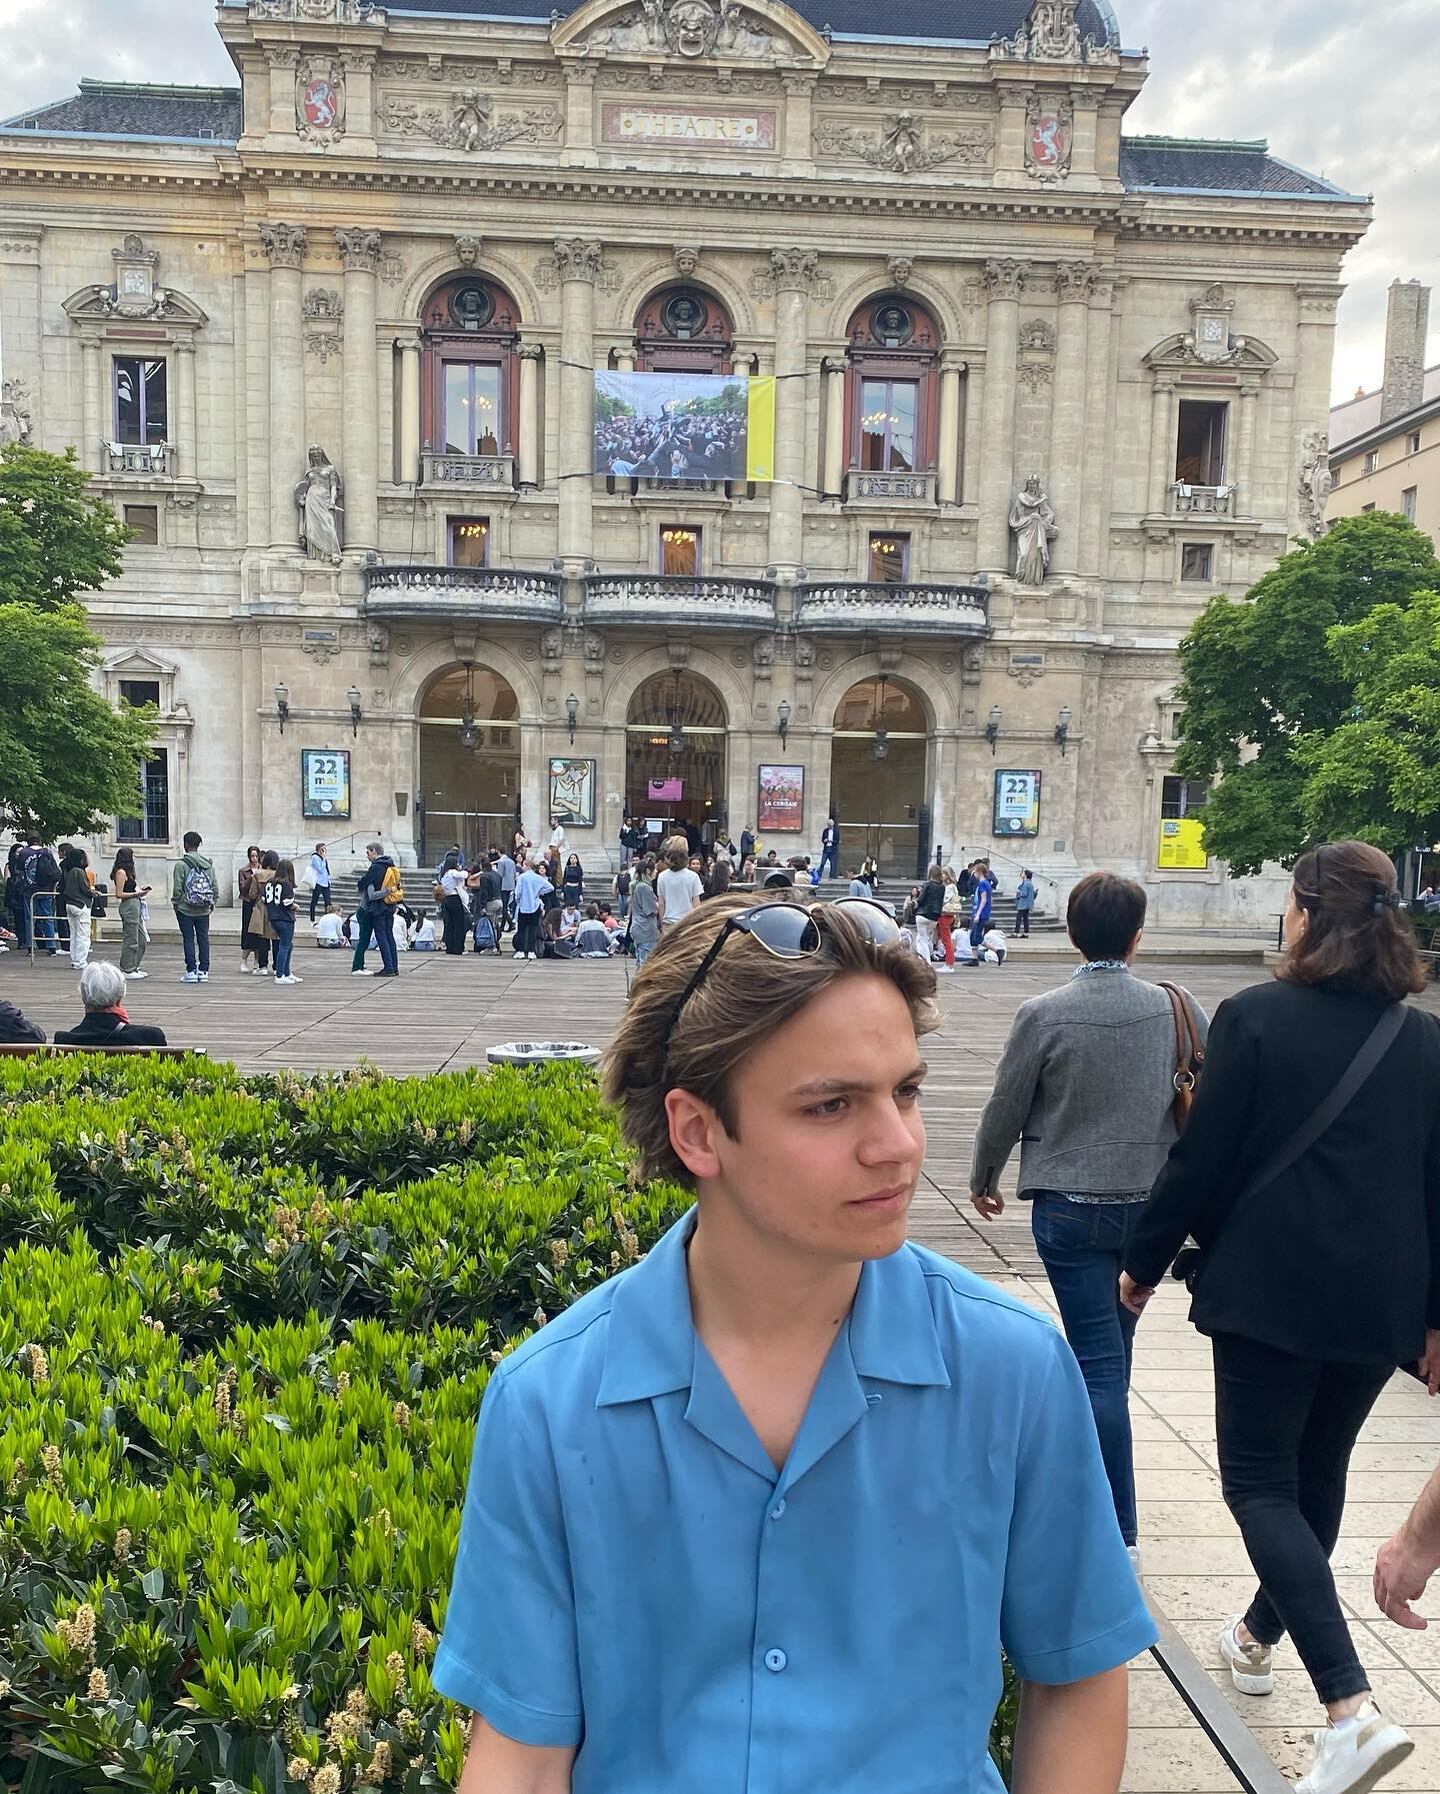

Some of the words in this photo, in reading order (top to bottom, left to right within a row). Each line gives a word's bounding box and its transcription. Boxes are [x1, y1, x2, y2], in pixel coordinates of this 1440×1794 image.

[636, 115, 742, 139] THEATRE
[314, 759, 338, 774] 22
[1006, 778, 1028, 793] 22
